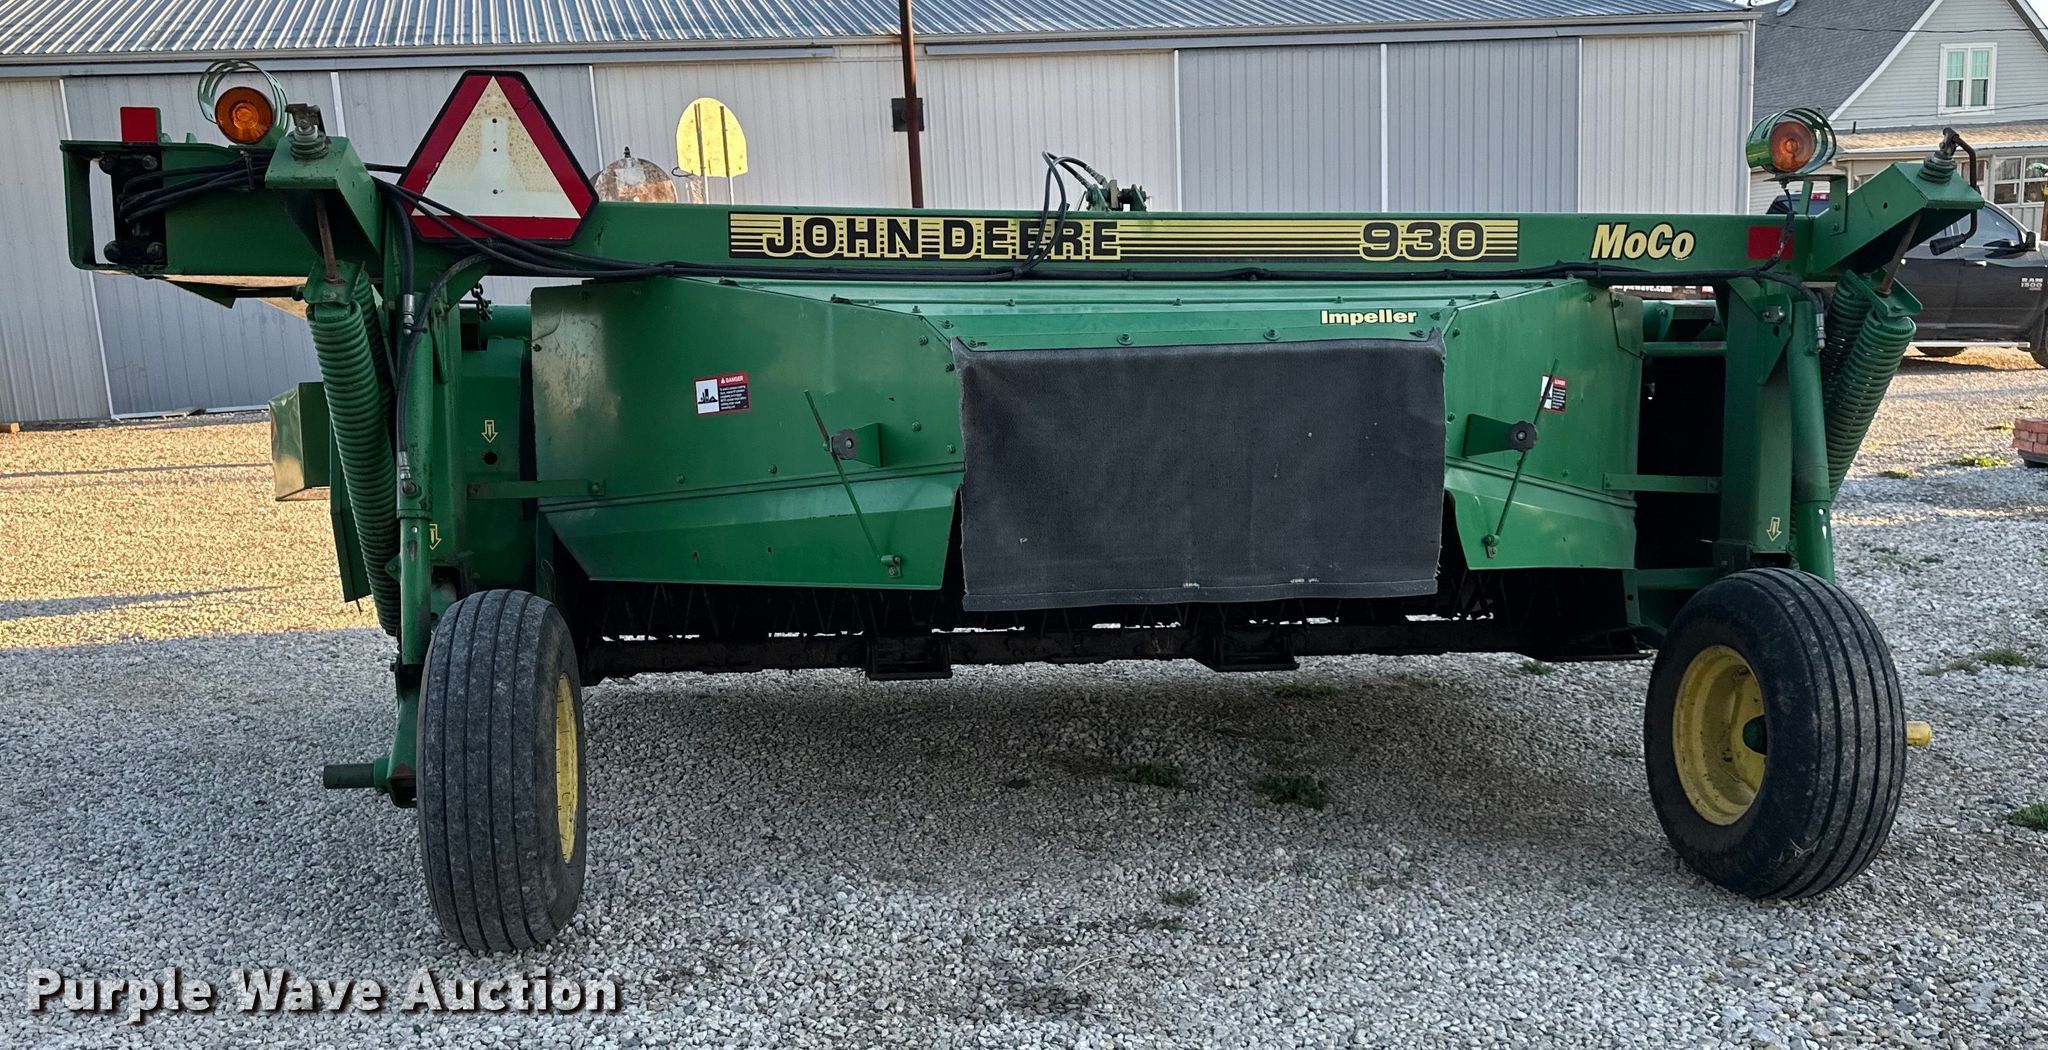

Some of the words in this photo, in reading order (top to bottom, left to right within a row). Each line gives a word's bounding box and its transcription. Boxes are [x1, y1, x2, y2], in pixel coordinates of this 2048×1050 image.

[763, 216, 923, 260] JOHN
[939, 217, 1121, 261] DEERE
[1359, 220, 1488, 262] 930
[1590, 222, 1696, 261] MoCo
[1320, 308, 1418, 326] Impeller
